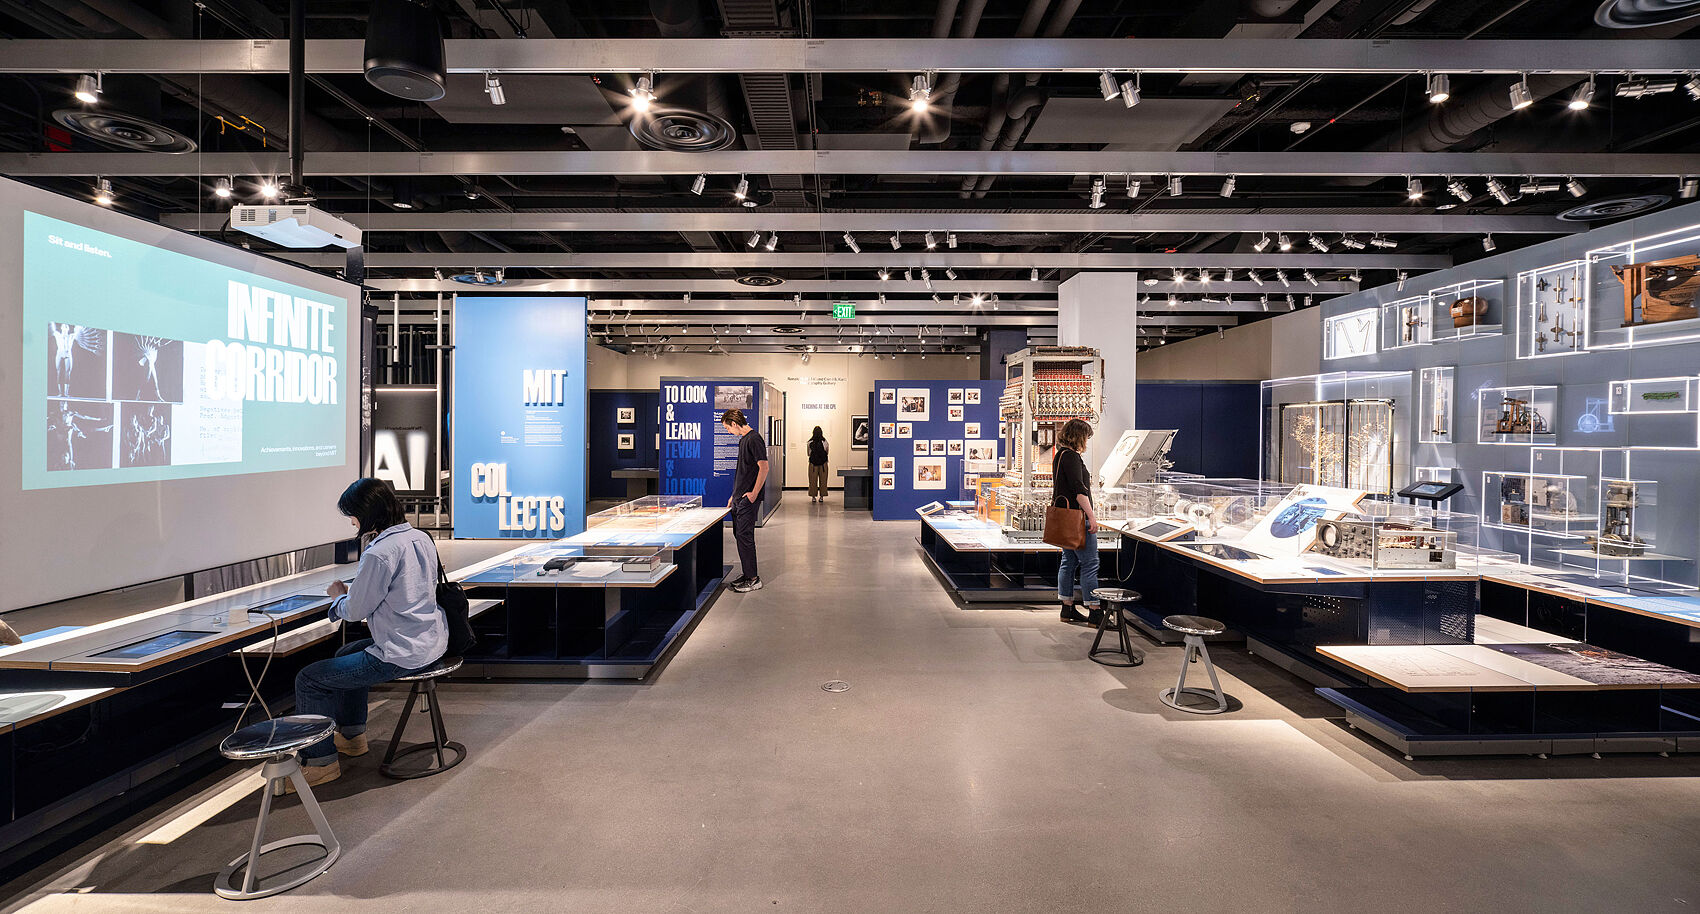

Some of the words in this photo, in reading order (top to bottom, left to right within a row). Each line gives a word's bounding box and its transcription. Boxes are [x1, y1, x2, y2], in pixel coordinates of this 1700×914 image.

[48, 234, 63, 246] Sit
[64, 240, 83, 251] and
[227, 280, 335, 354] INFINITE
[838, 306, 852, 318] EXIT
[205, 339, 338, 405] CORRIDOR
[523, 369, 567, 404] MIT
[664, 385, 679, 403] TO
[680, 385, 708, 404] LOOK
[665, 403, 675, 422] &
[665, 422, 701, 440] LEARN
[374, 430, 429, 490] AI
[471, 462, 512, 498] COL
[499, 496, 565, 531] LECTS
